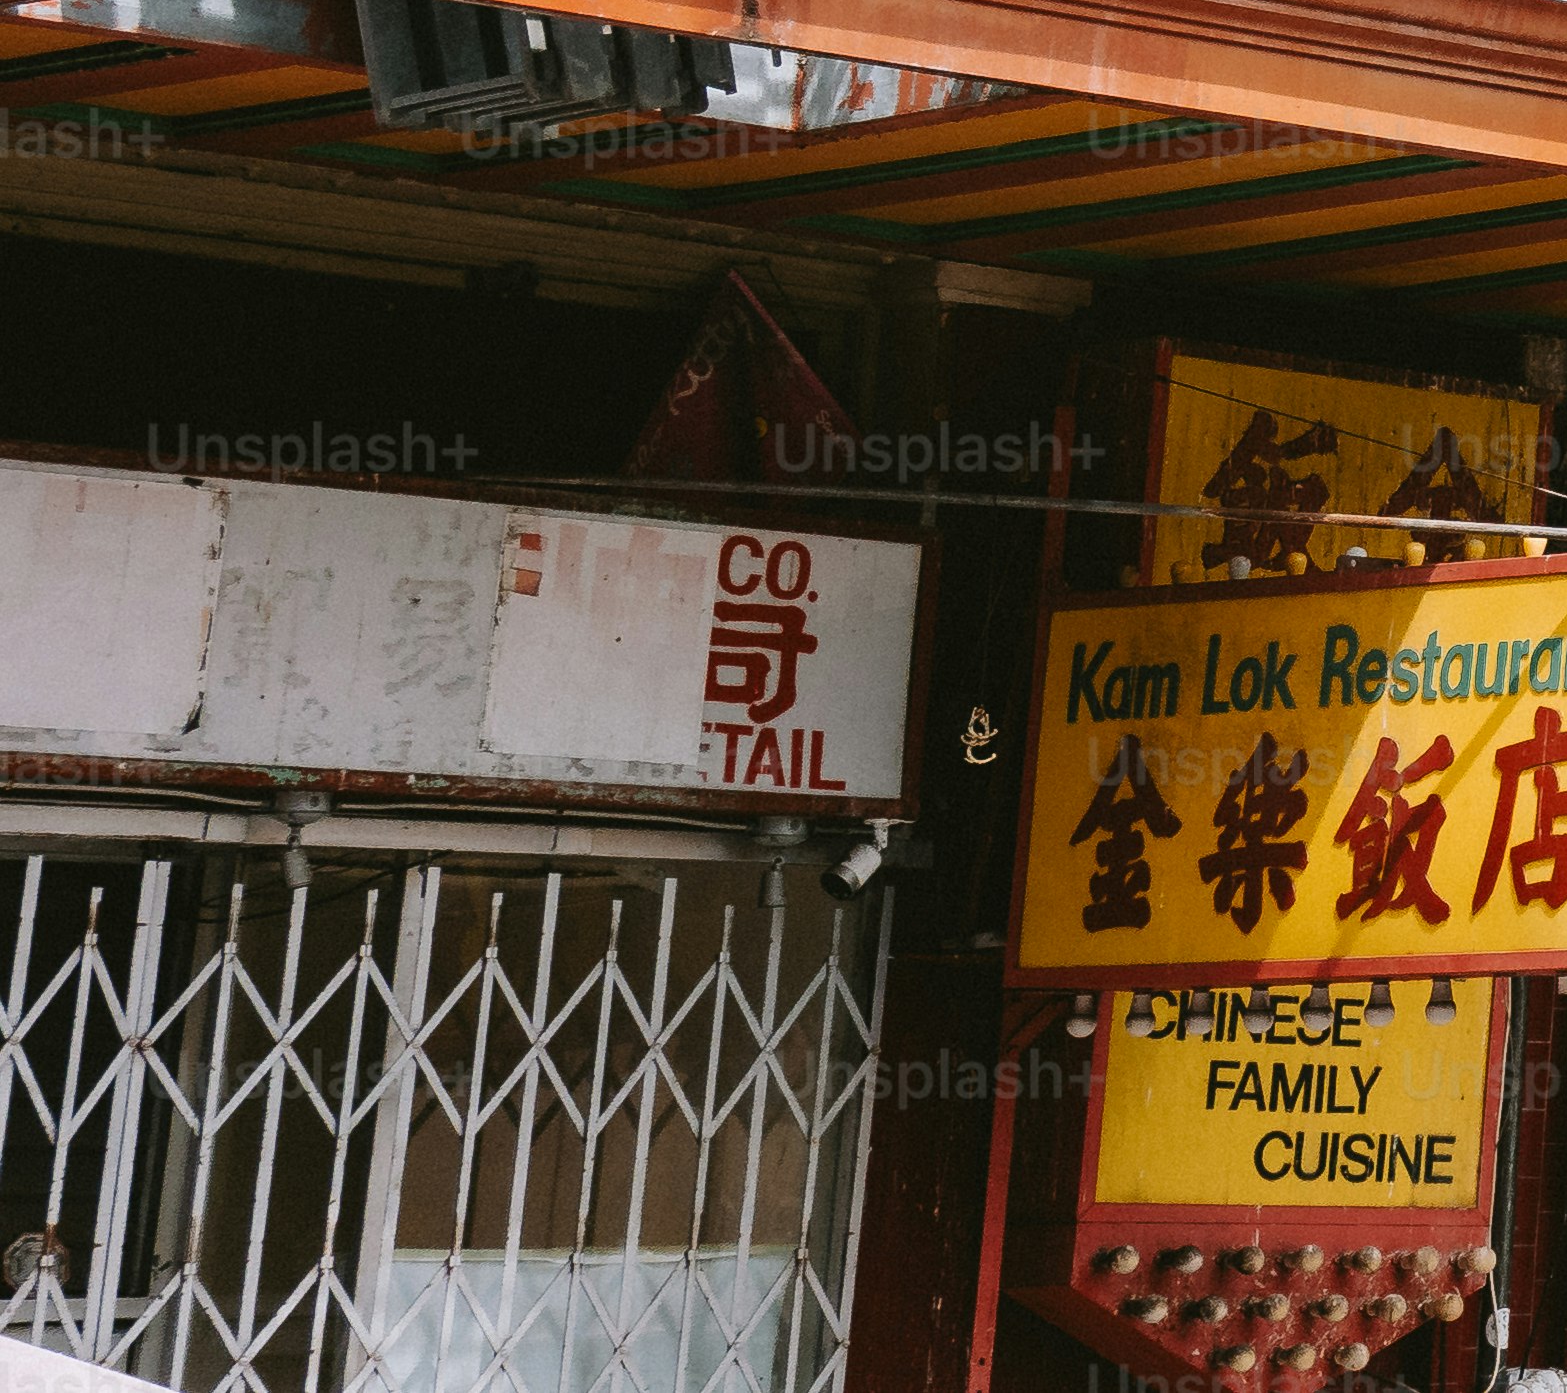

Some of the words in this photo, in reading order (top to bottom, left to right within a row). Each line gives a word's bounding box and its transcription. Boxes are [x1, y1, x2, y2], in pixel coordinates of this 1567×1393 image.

[717, 534, 819, 603] CO.
[1066, 641, 1179, 725] Kam
[1201, 633, 1297, 715] Lok
[1142, 987, 1364, 1050] CHINESE
[1205, 1063, 1382, 1115] FAMILY
[1253, 1133, 1456, 1185] CUISINE
